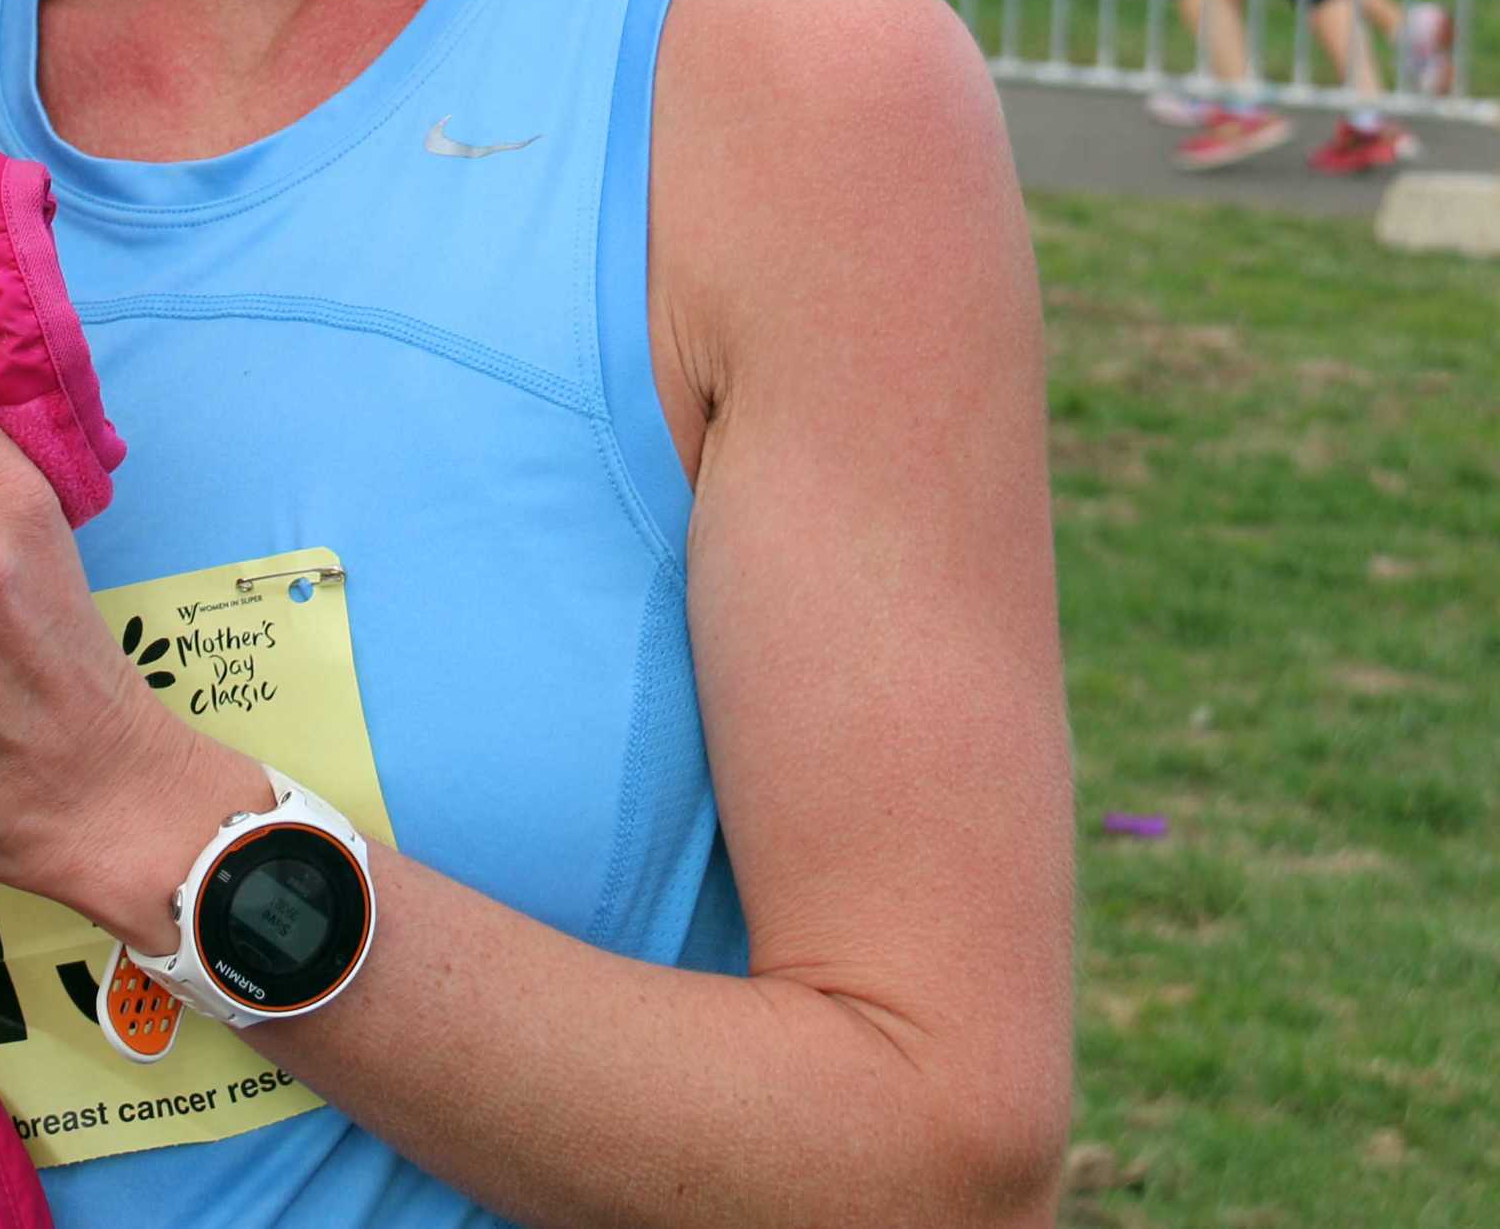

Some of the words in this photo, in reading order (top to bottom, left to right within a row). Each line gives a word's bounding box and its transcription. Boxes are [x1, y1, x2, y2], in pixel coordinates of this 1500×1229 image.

[199, 602, 229, 612] WOMEN
[230, 598, 239, 607] IN
[241, 595, 262, 606] SUPER
[177, 620, 276, 667] Mother's
[209, 655, 255, 684] Day
[215, 960, 266, 1000] GARMIN
[13, 1102, 108, 1140] breast
[118, 1088, 217, 1122] cancer
